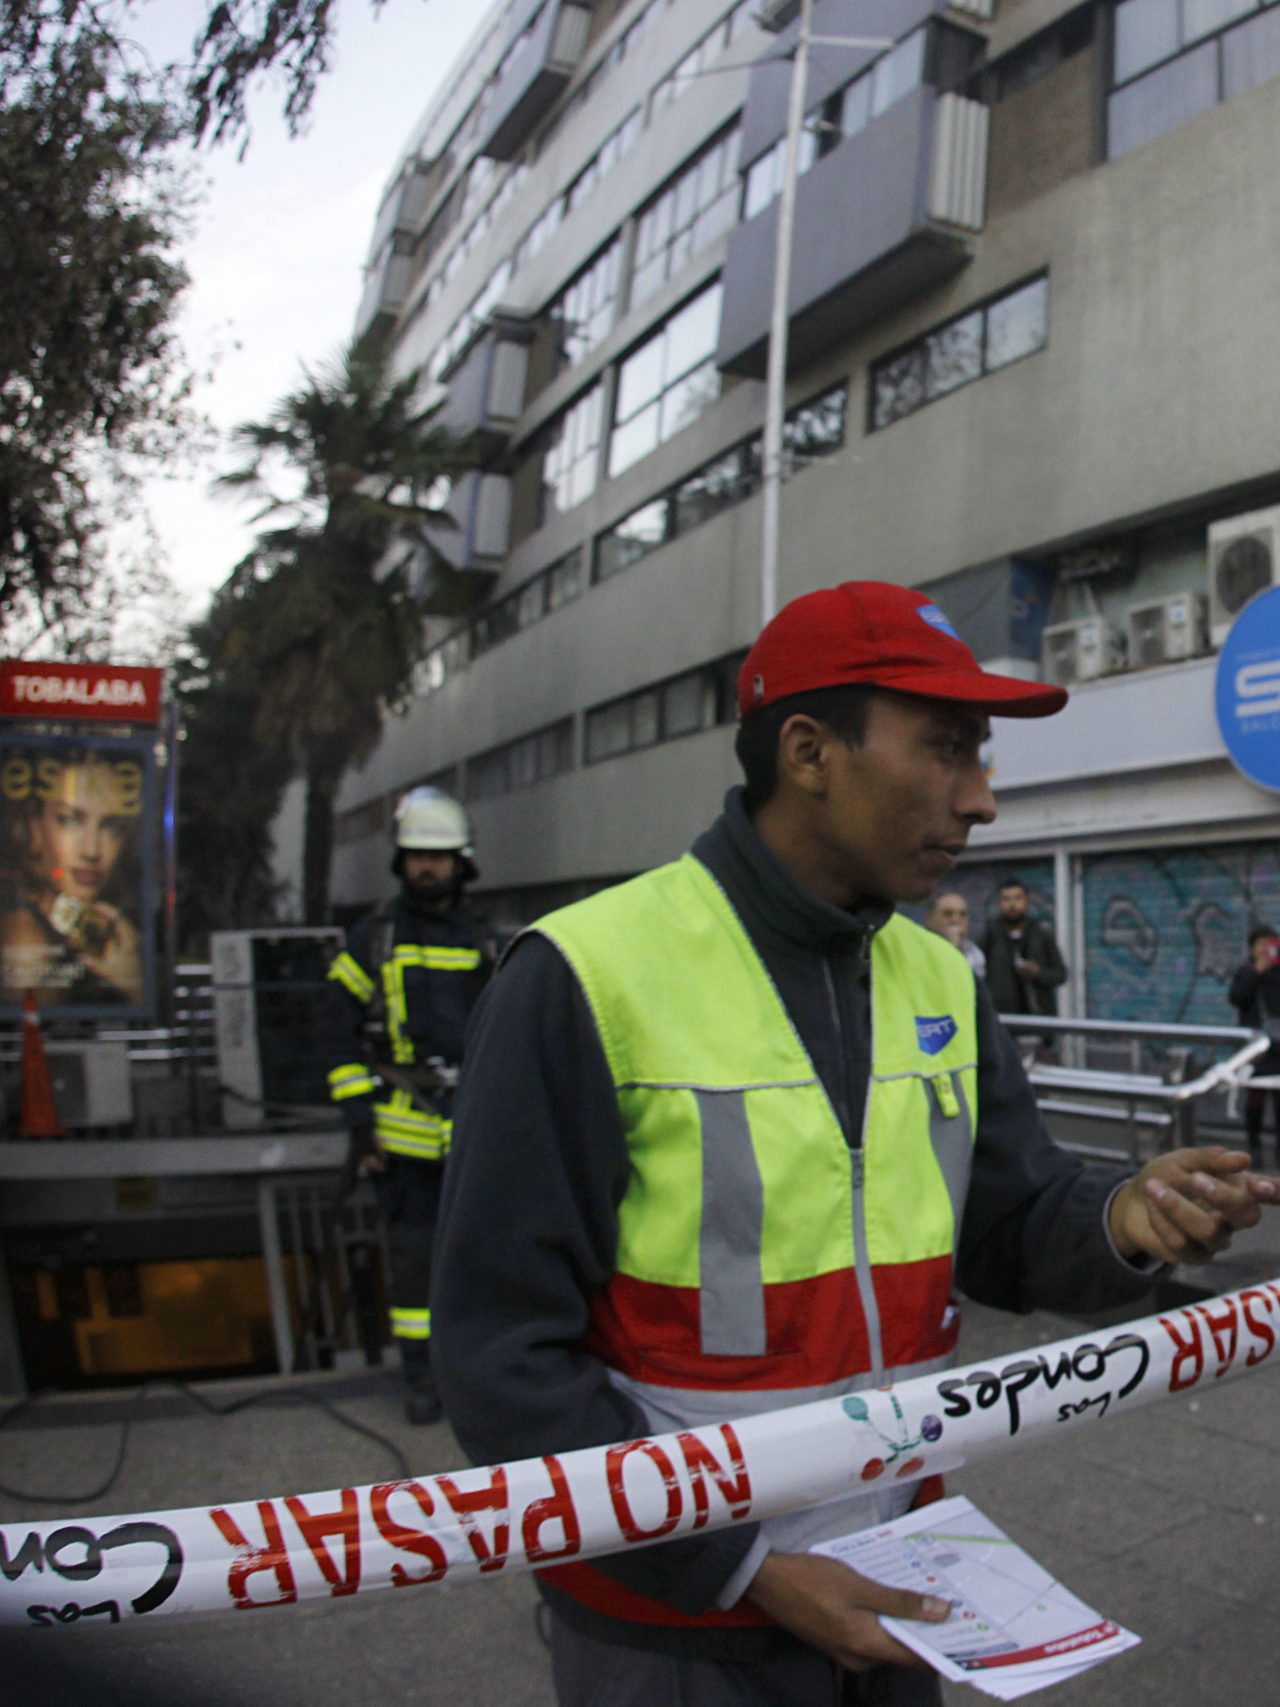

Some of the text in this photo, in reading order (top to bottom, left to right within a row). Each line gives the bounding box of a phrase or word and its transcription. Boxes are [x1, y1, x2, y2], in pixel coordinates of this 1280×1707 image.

[12, 674, 147, 706] TOBALABA
[937, 1333, 1150, 1436] Condes
[1056, 1390, 1112, 1423] Las
[208, 1422, 753, 1610] NO PASAR
[26, 1599, 121, 1627] Las
